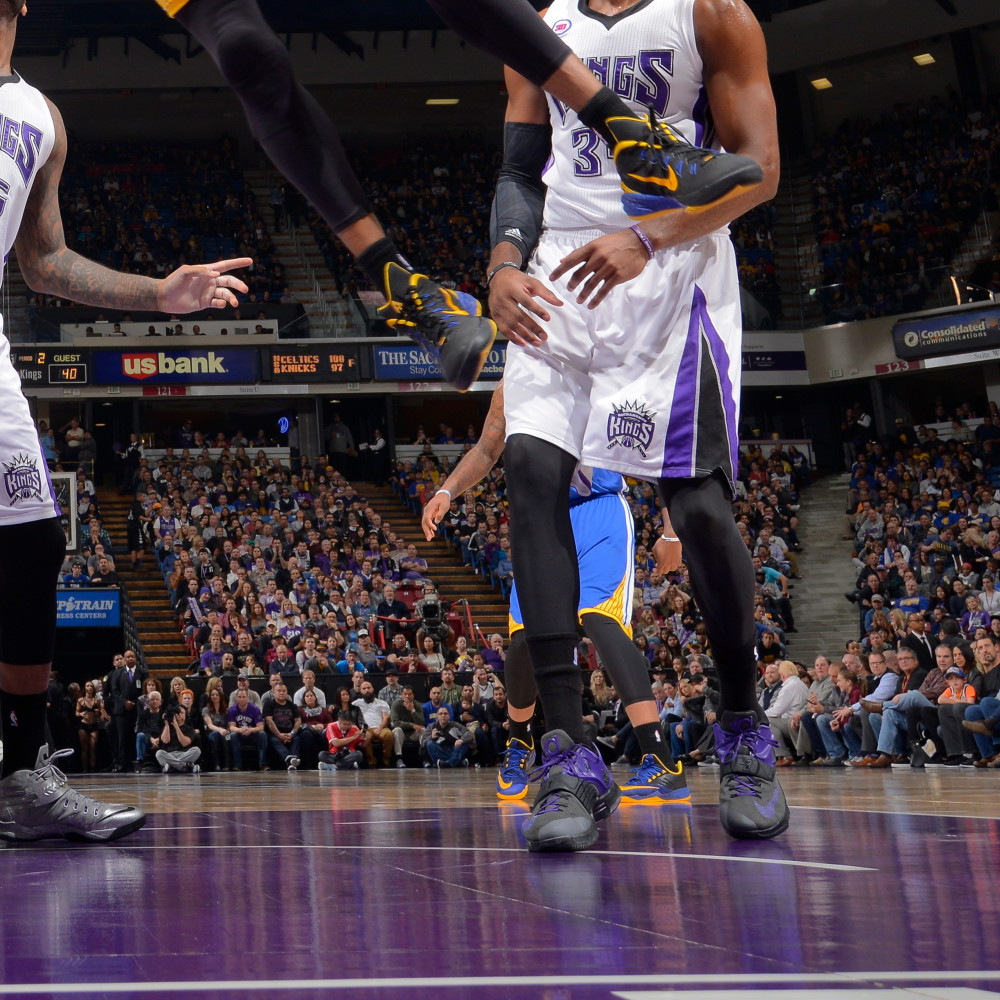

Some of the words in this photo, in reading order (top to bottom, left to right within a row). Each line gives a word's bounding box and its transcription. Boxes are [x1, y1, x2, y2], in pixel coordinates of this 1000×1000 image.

[550, 49, 675, 125] NGS
[571, 127, 613, 178] 3
[921, 321, 986, 339] Consolidated
[922, 331, 987, 345] communications
[37, 352, 46, 365] 2
[53, 354, 81, 362] GUEST
[280, 355, 320, 364] CELTICS
[329, 355, 345, 363] 108
[379, 351, 408, 365] THE
[281, 364, 317, 373] KNICKS
[331, 364, 343, 372] 97
[410, 366, 427, 375] Stay
[886, 361, 910, 373] 123
[20, 370, 42, 380] Kings
[61, 368, 77, 380] 40
[157, 387, 172, 396] 121
[609, 415, 653, 445] KINGS
[6, 471, 41, 496] KINGS
[73, 600, 114, 610] TRAIN
